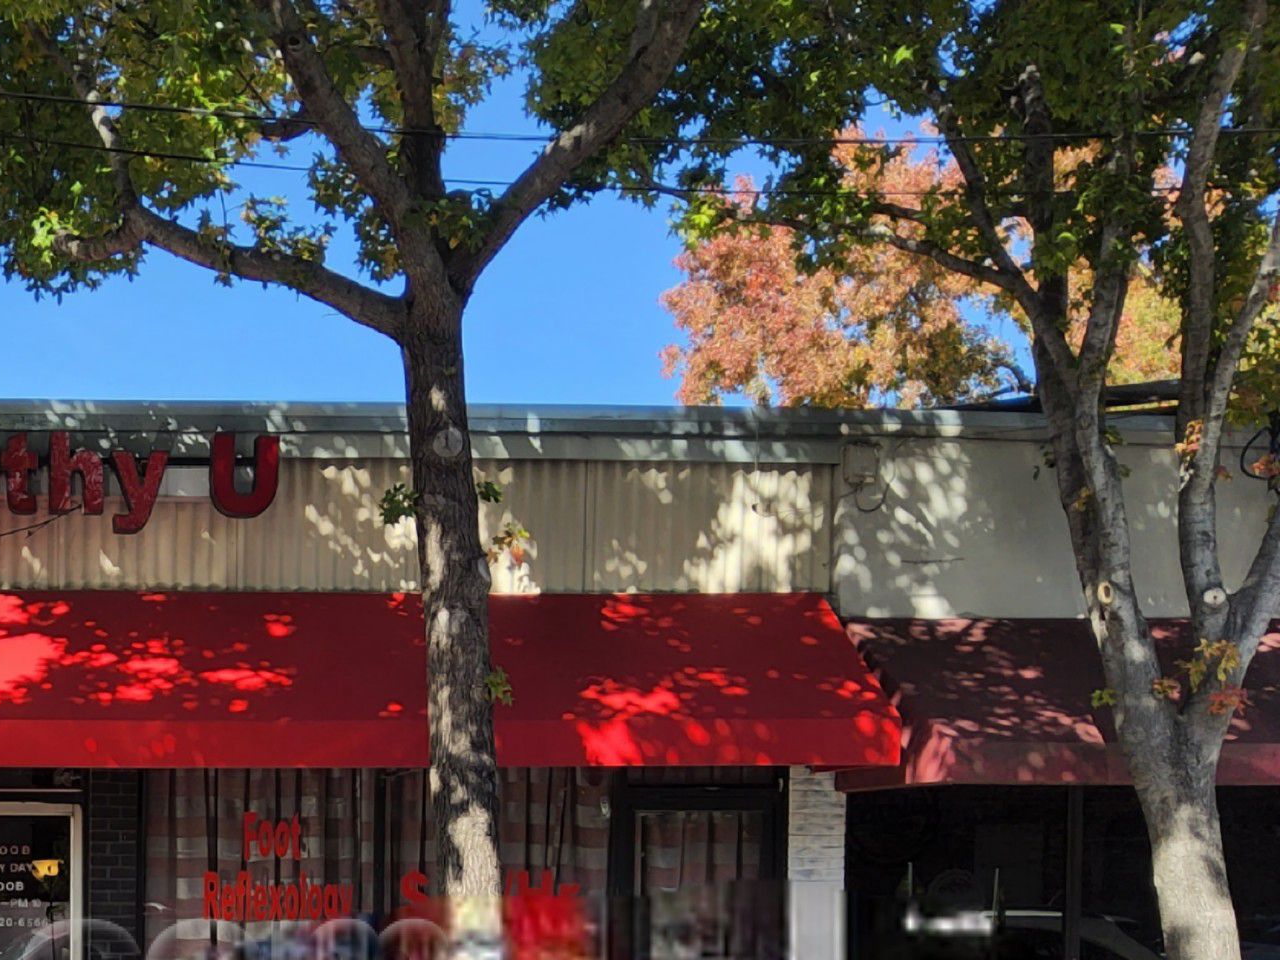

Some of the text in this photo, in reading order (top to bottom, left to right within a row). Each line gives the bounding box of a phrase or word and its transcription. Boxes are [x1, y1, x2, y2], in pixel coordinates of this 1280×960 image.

[209, 427, 281, 519] U
[244, 811, 301, 862] Foot
[10, 863, 34, 873] DAY
